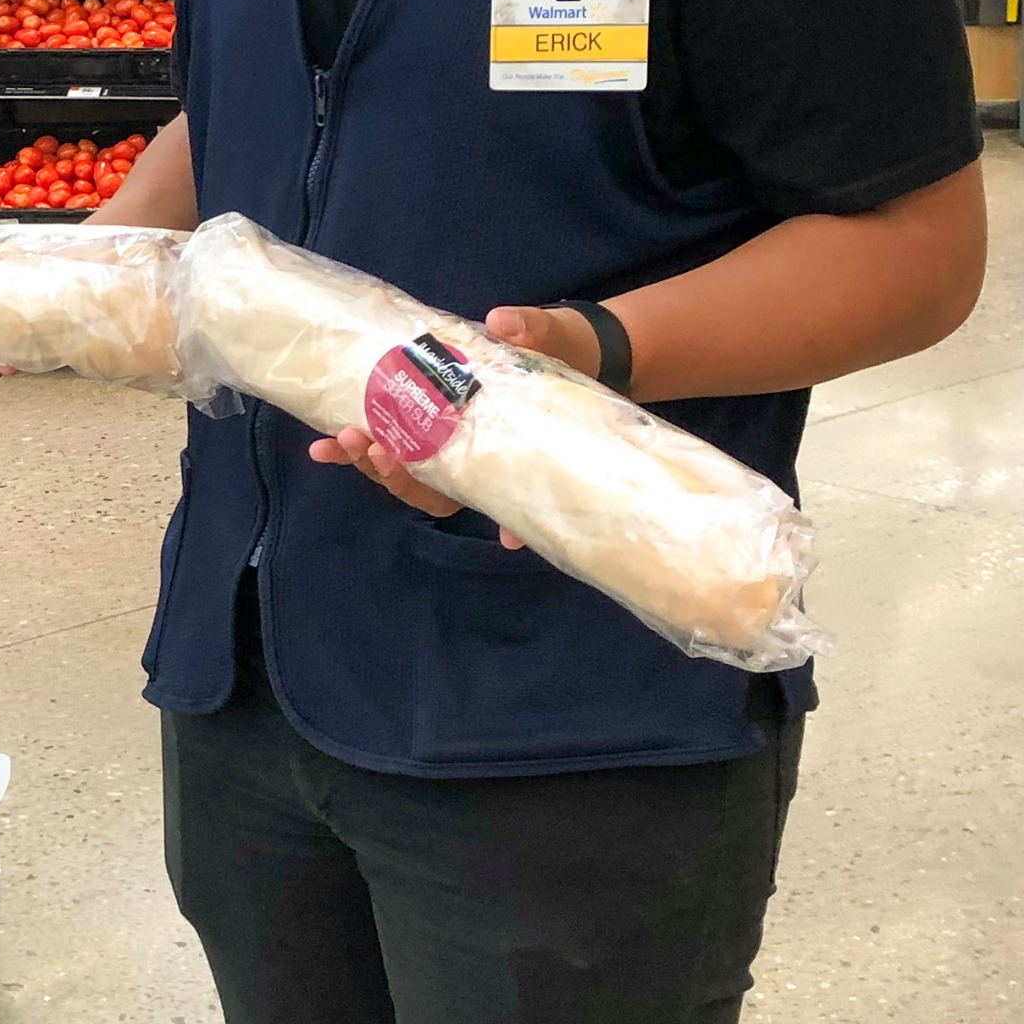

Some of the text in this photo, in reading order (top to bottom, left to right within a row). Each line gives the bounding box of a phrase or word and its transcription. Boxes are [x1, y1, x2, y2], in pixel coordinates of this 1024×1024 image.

[528, 6, 588, 19] Walmart
[536, 32, 603, 53] ERICK
[383, 380, 416, 412] SUPER
[411, 408, 434, 433] SUB
[394, 369, 441, 419] SUPREME
